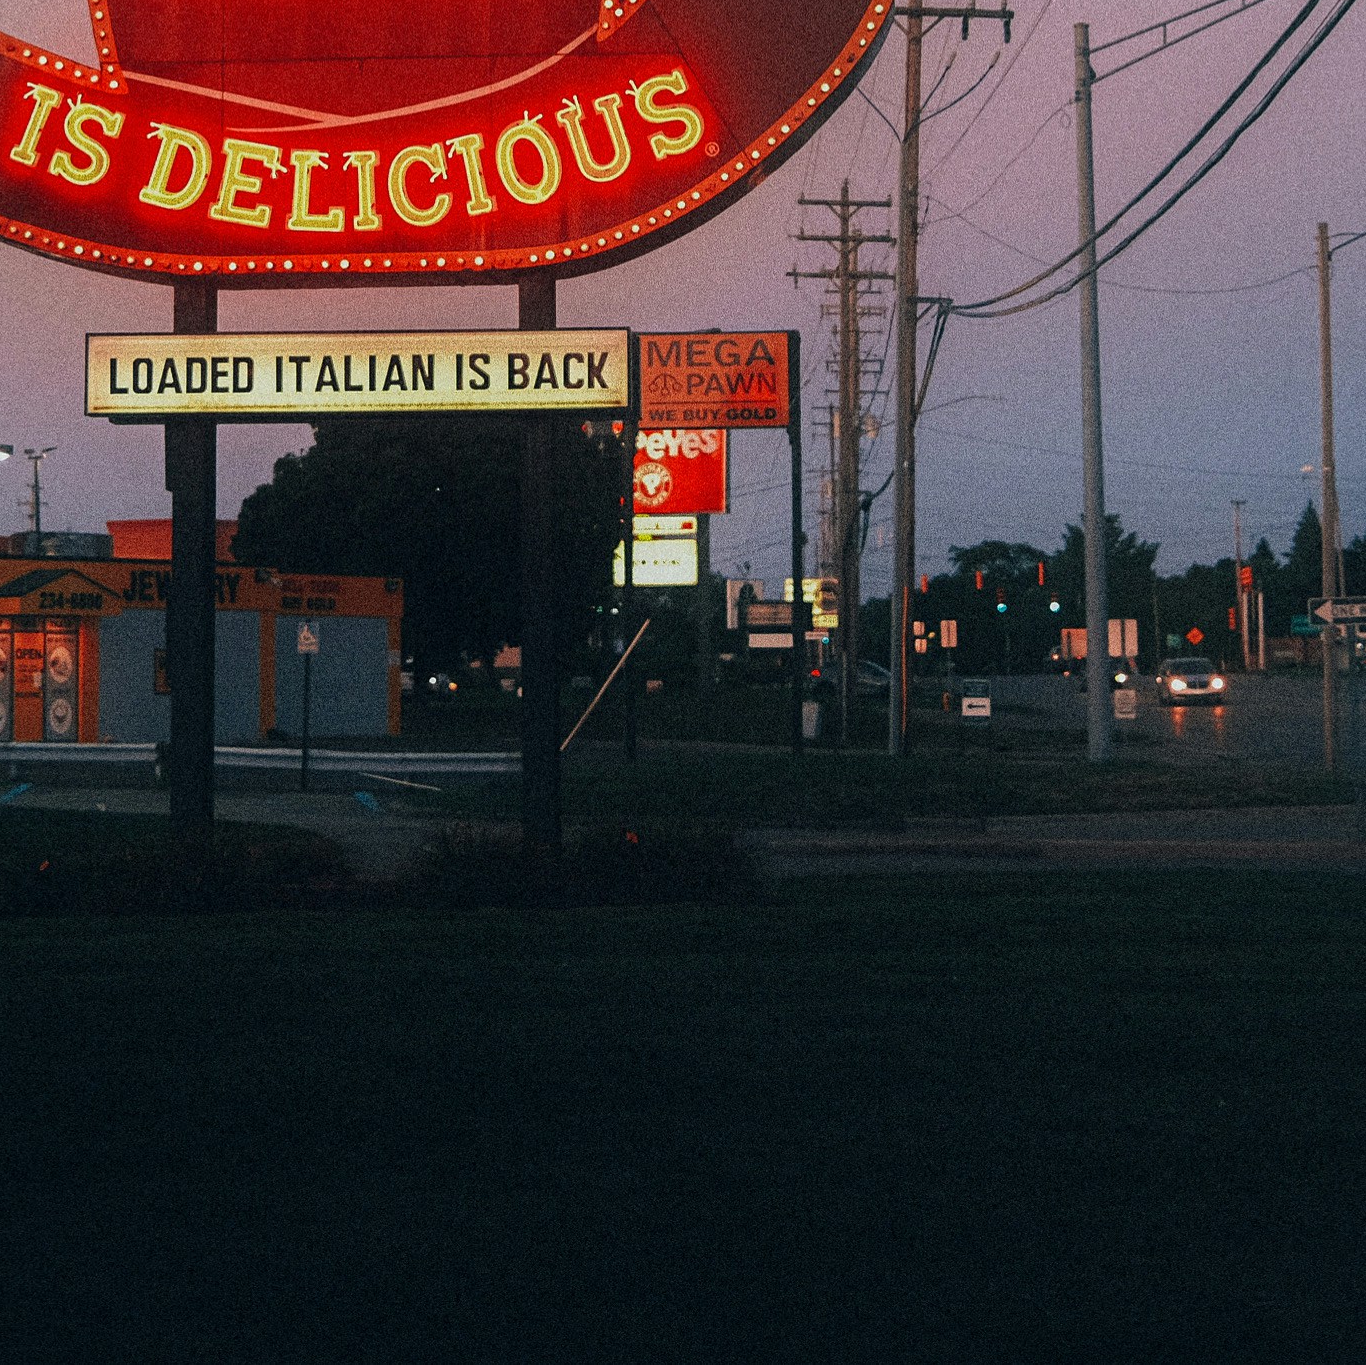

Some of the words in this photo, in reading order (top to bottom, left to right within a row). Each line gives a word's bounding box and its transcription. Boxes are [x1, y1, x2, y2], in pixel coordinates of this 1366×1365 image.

[9, 81, 127, 186] IS
[138, 68, 705, 234] DELICIOUS
[646, 338, 776, 369] MEGA
[109, 356, 255, 395] LOADED
[275, 353, 435, 393] ITALIAN
[455, 352, 492, 392] IS
[507, 350, 610, 391] BACK
[685, 371, 778, 397] PAWN
[648, 409, 678, 422] WE
[683, 408, 722, 422] BUY
[725, 407, 778, 421] GOLD
[1332, 604, 1356, 618] ONE
